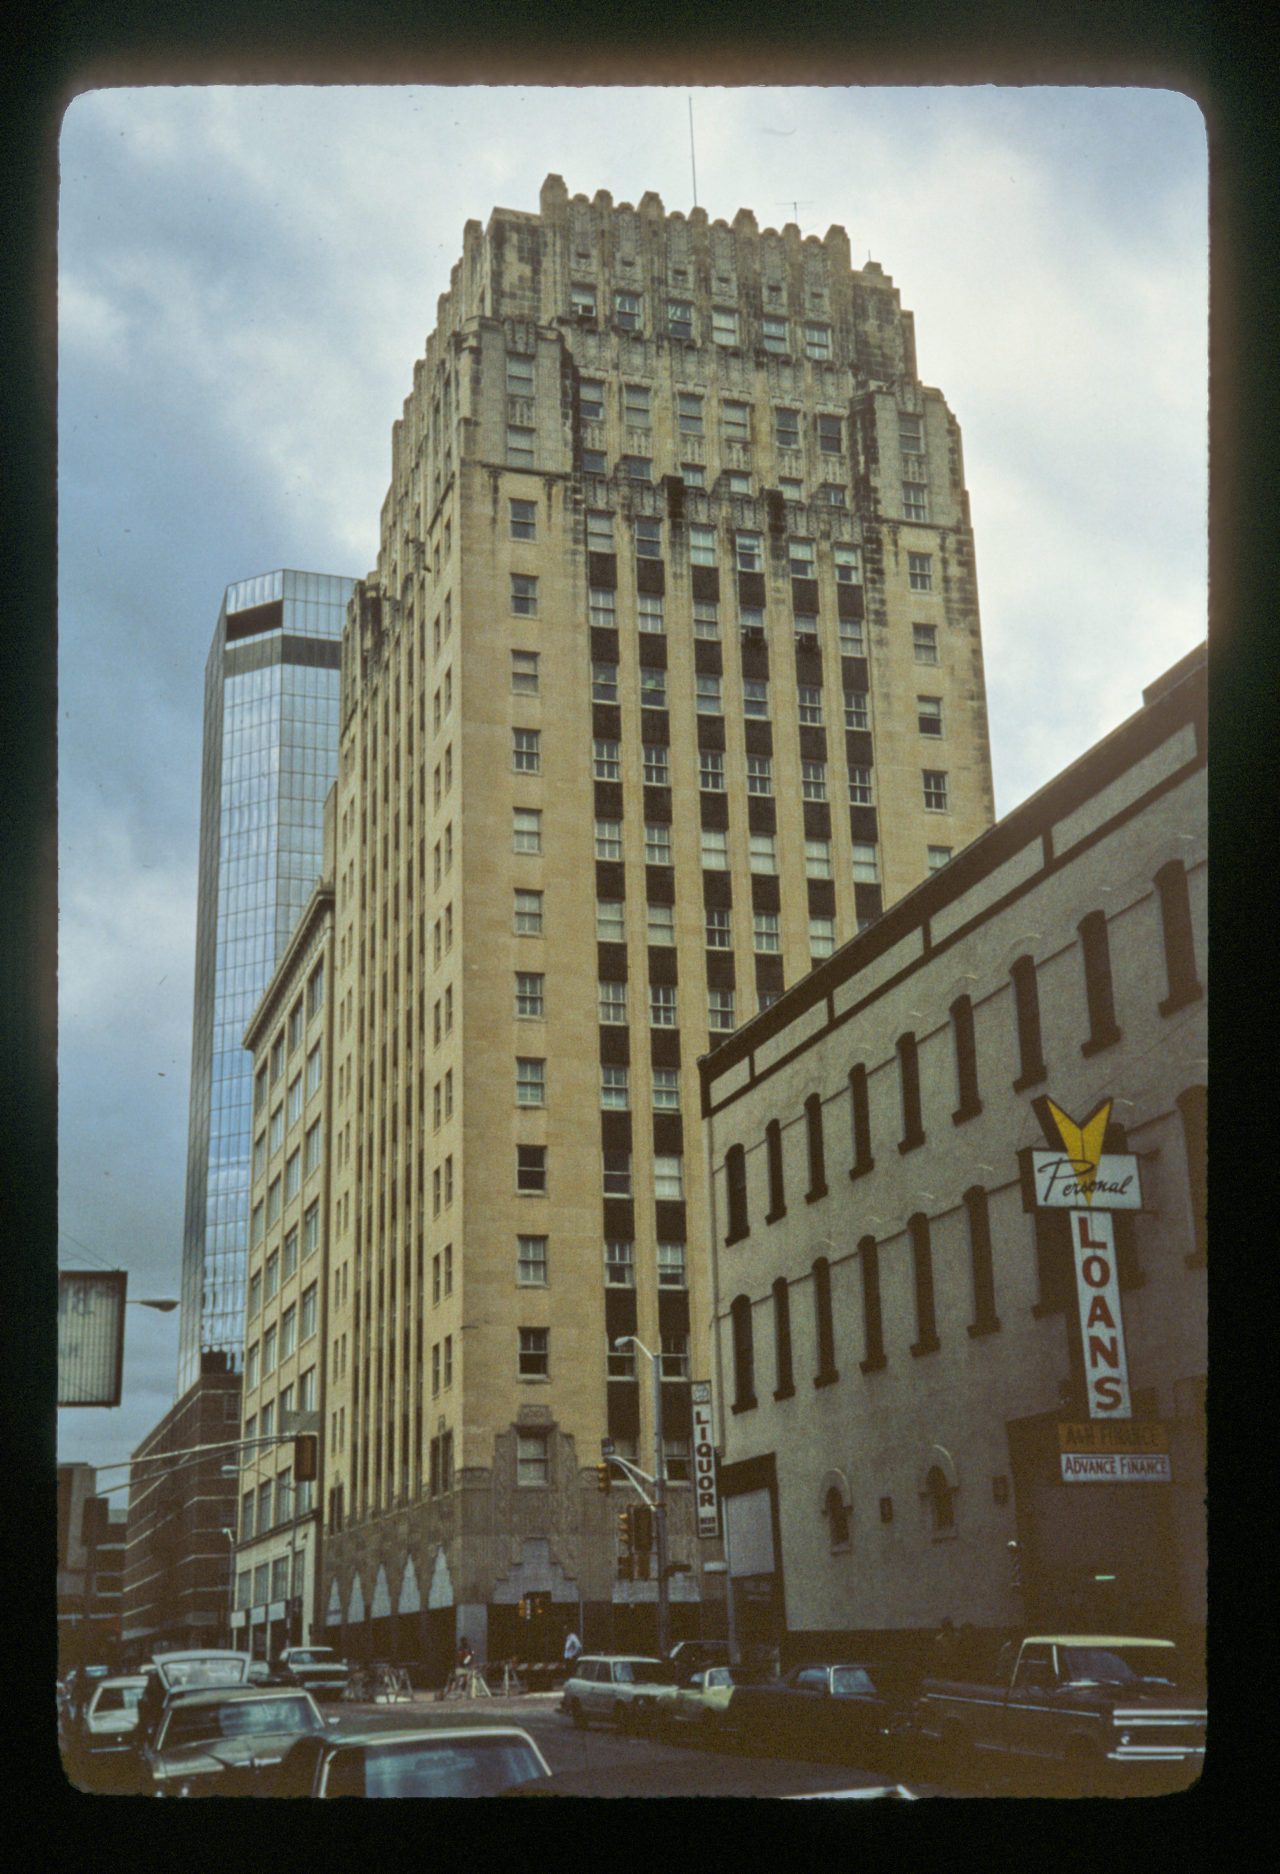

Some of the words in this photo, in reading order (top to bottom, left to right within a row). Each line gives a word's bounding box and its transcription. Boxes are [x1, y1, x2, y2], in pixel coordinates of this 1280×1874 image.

[1037, 1157, 1133, 1201] Personal
[1078, 1216, 1122, 1411] LOANS
[696, 1411, 714, 1507] LIQUOR
[1065, 1456, 1116, 1474] ADVANCE
[1120, 1457, 1168, 1475] FINANCE
